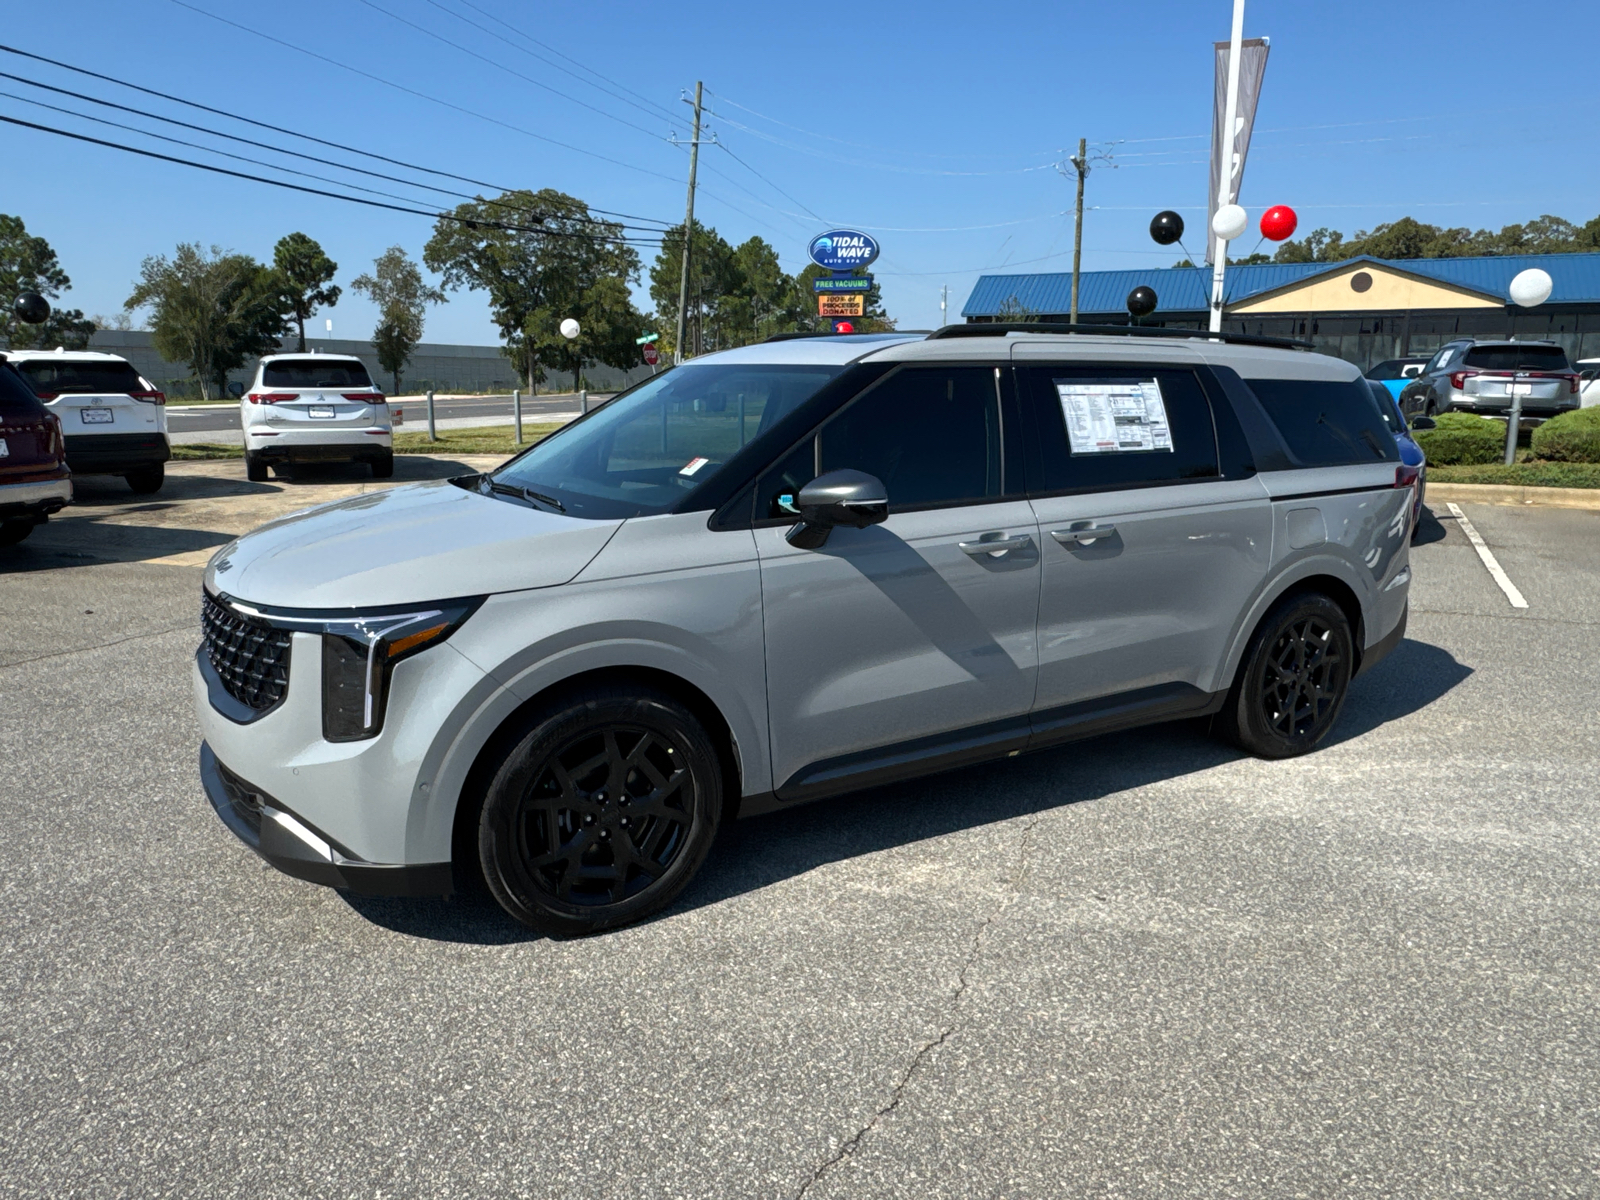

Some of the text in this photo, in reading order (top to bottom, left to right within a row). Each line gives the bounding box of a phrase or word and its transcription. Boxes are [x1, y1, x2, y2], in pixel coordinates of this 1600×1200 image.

[833, 237, 864, 247] TIDAL
[837, 248, 871, 257] WAVE
[815, 279, 868, 288] FREE VACUUMS
[645, 350, 656, 358] STOP
